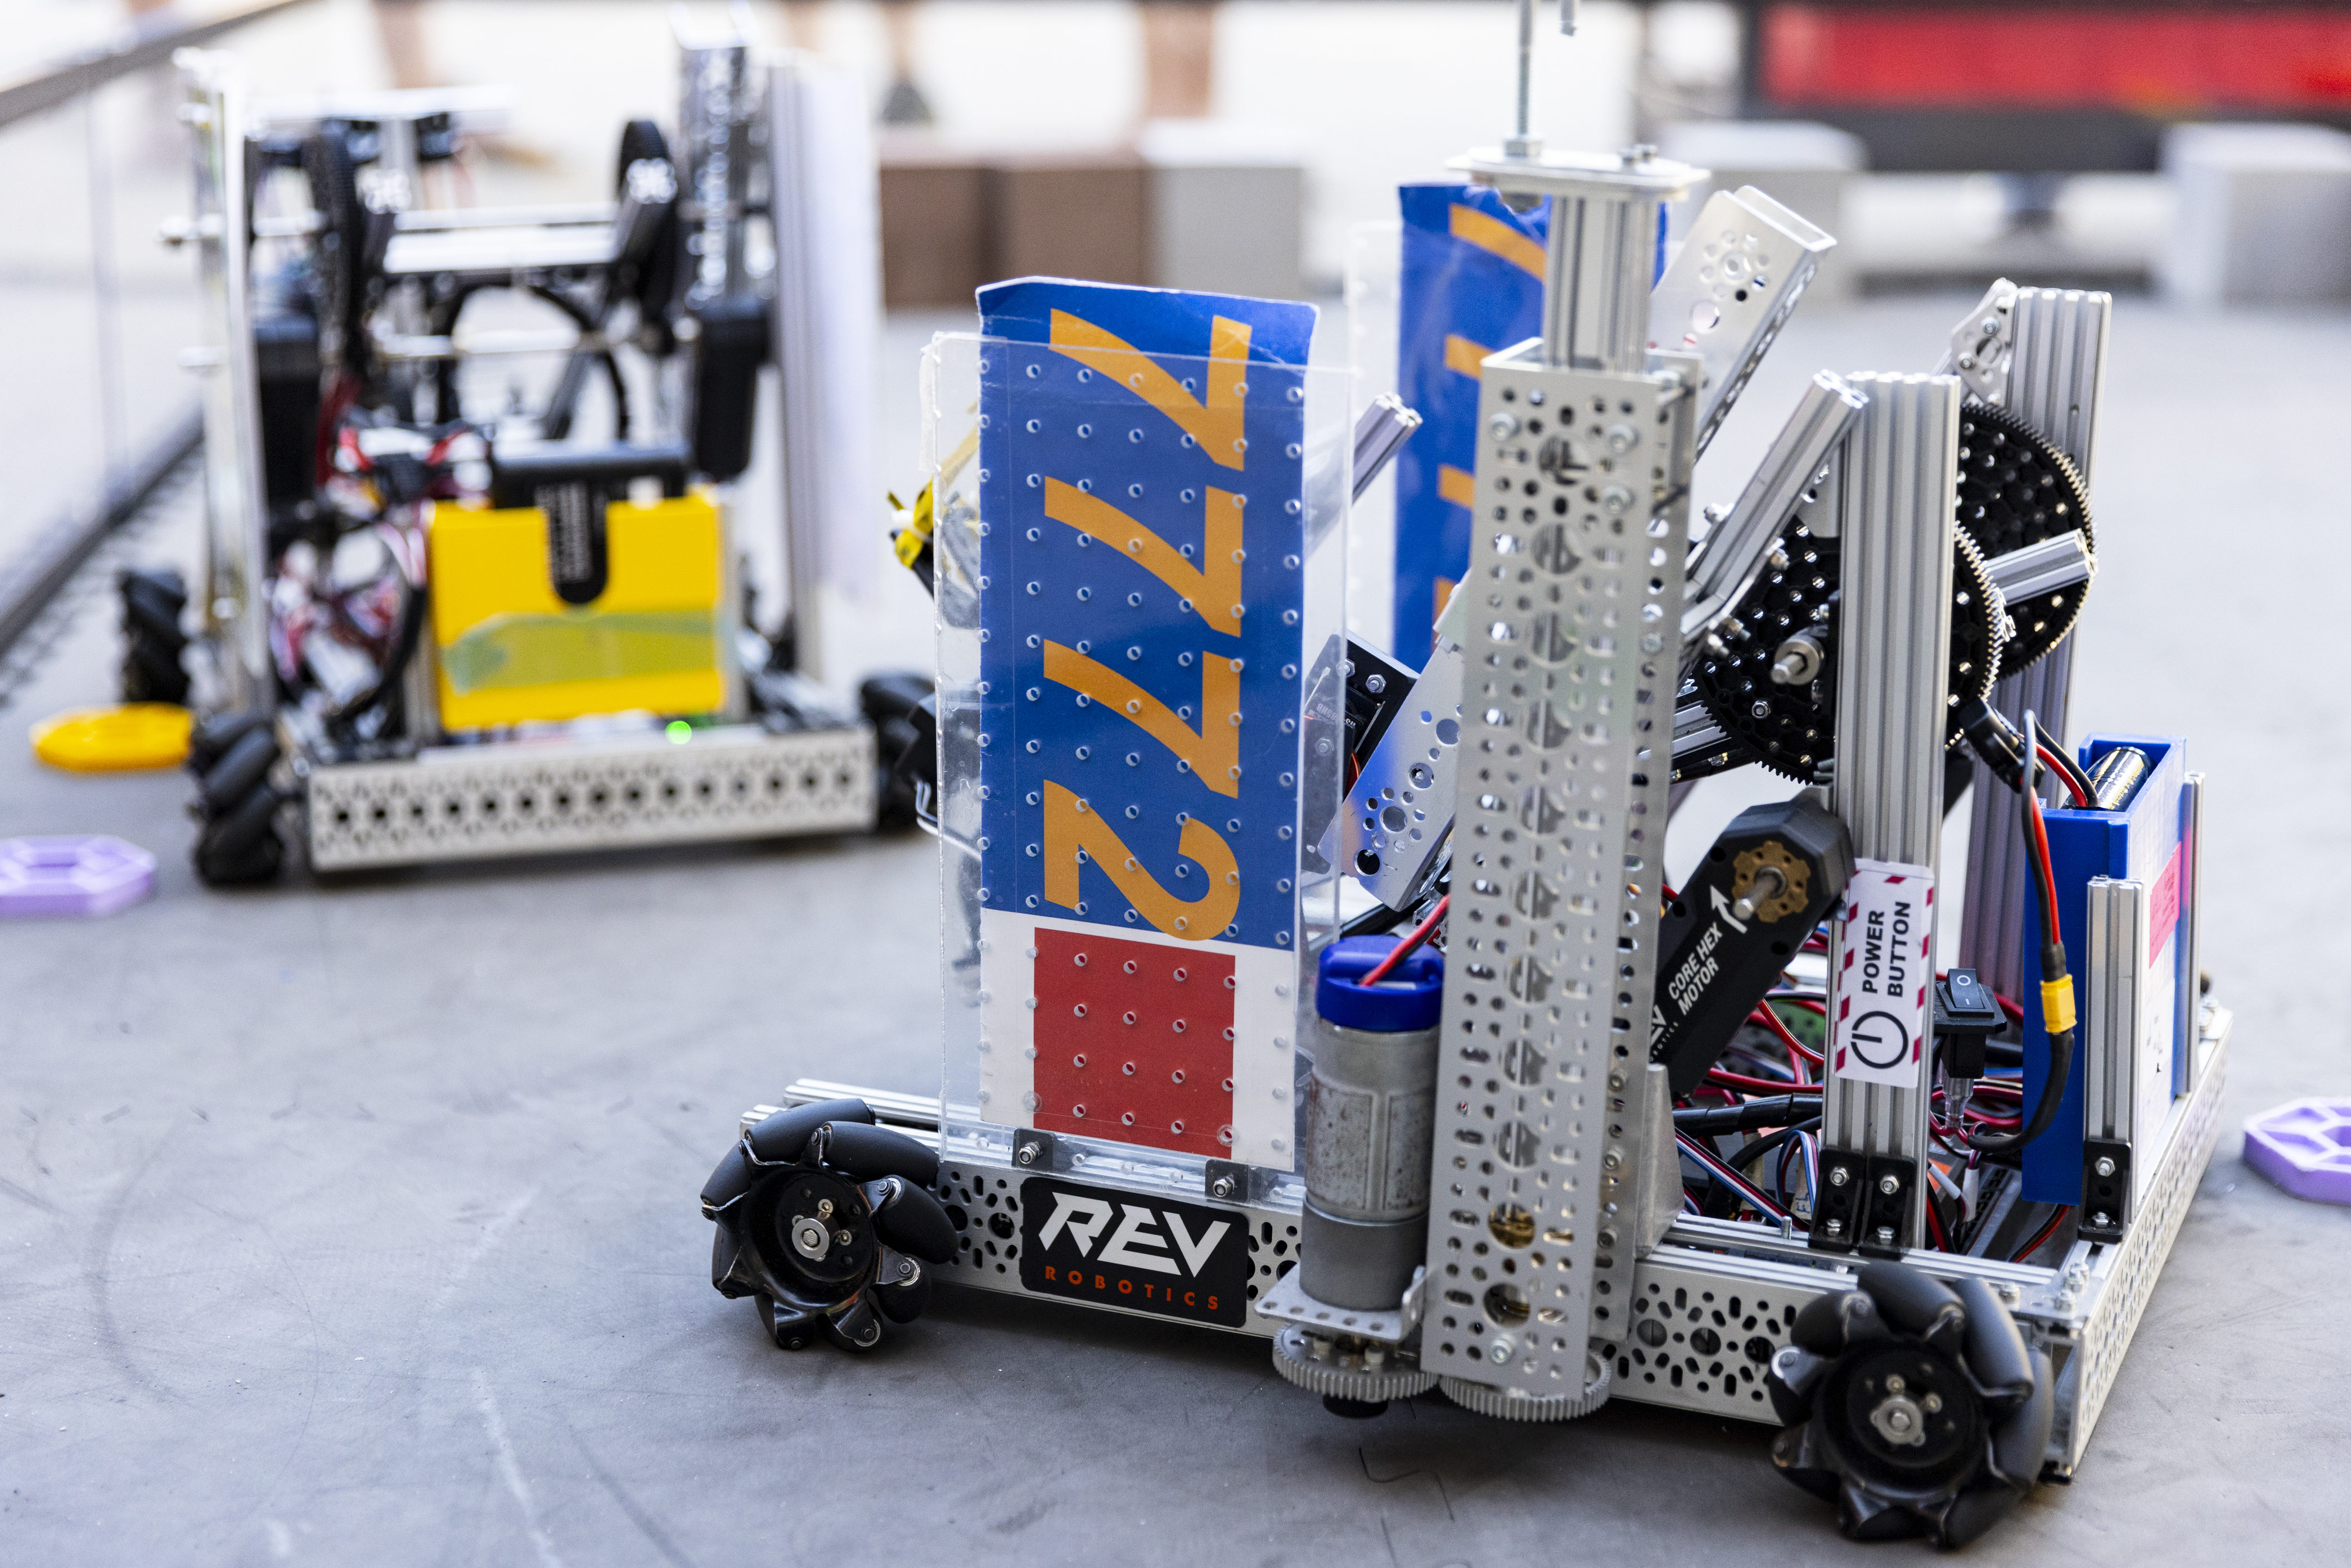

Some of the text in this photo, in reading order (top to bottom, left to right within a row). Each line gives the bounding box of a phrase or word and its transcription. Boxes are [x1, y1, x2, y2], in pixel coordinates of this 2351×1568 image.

[1043, 308, 1252, 941] 7772
[1668, 922, 1723, 1000] CORE HEX
[1678, 956, 1719, 1016] MOTOR
[1862, 910, 1885, 994] POWER
[1888, 902, 1911, 998] BUTTON
[1649, 1021, 1679, 1062] OBOTICS
[1038, 1192, 1231, 1278] REV
[1045, 1266, 1218, 1310] ROBOTICS
